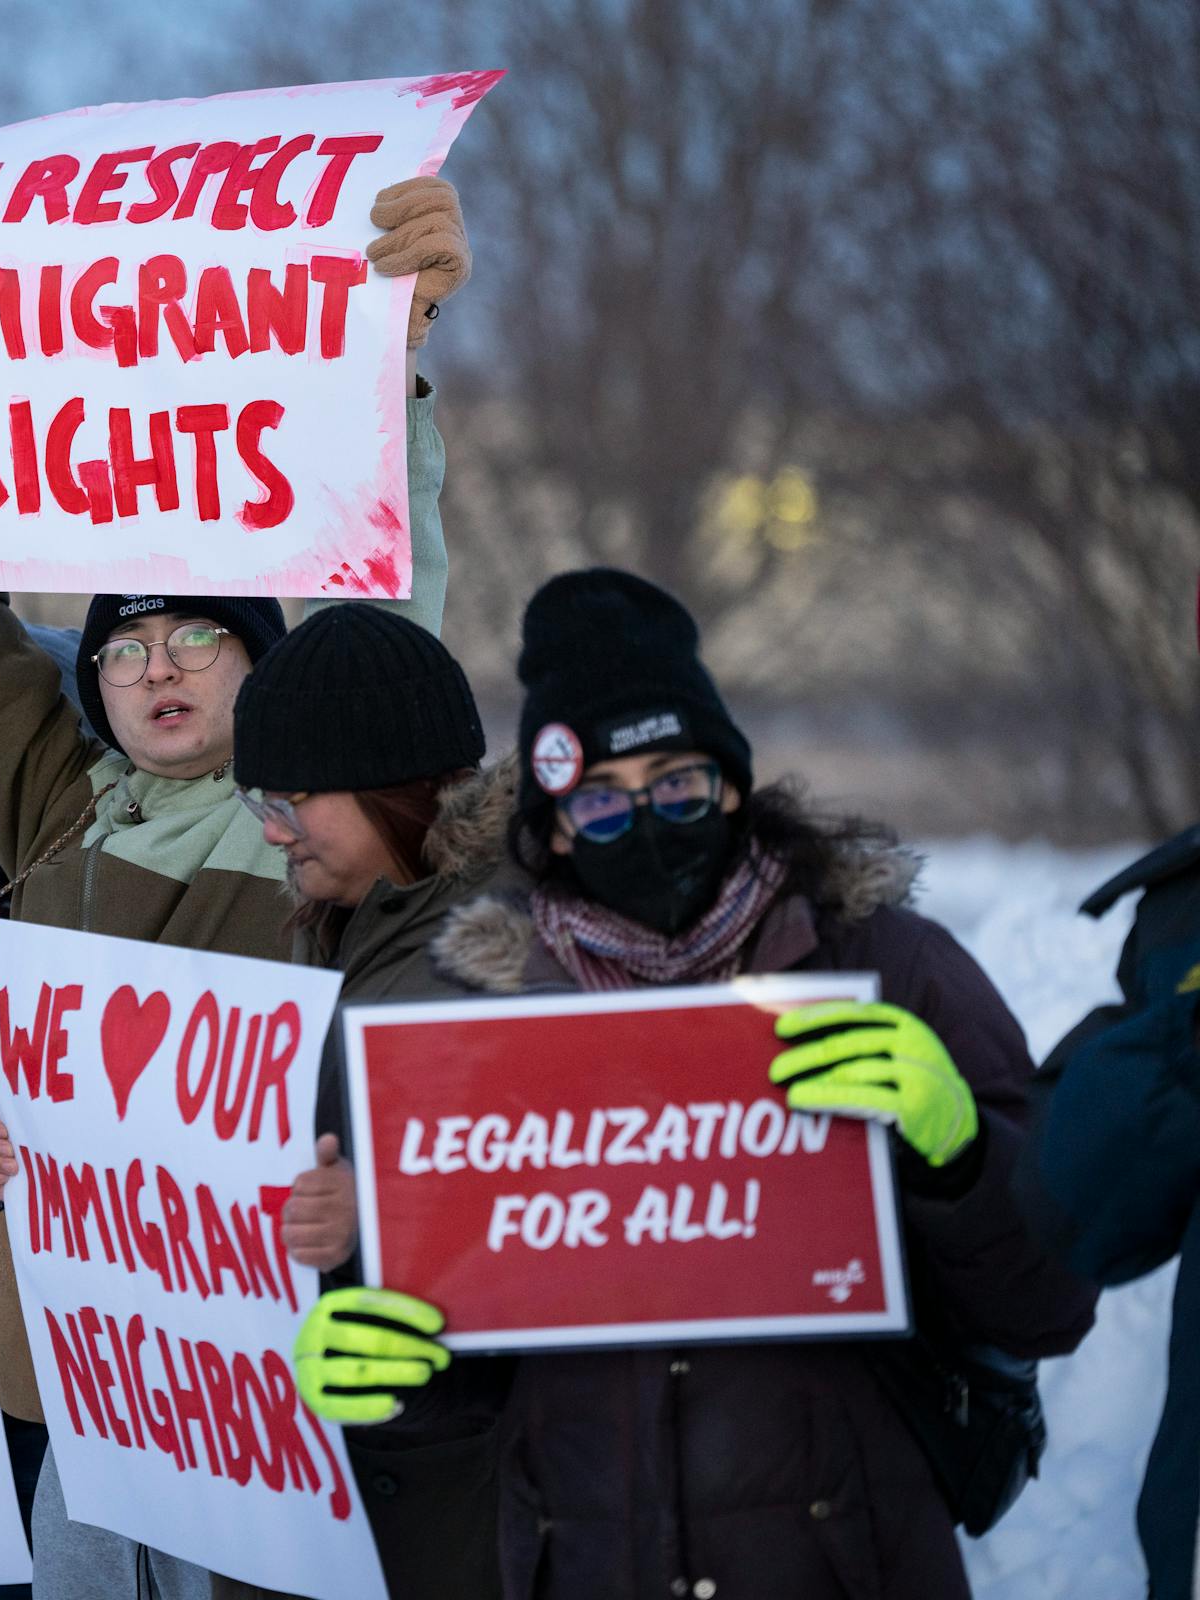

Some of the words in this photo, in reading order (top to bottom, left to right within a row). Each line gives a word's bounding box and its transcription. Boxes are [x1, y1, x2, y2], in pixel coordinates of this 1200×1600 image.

[3, 132, 384, 232] RESPECT
[119, 598, 165, 616] adidas
[176, 990, 302, 1148] OUR
[398, 1098, 832, 1175] LEGALIZATION
[19, 1144, 299, 1314] IMMIGRANT
[487, 1190, 610, 1253] FOR
[624, 1178, 760, 1246] ALL!
